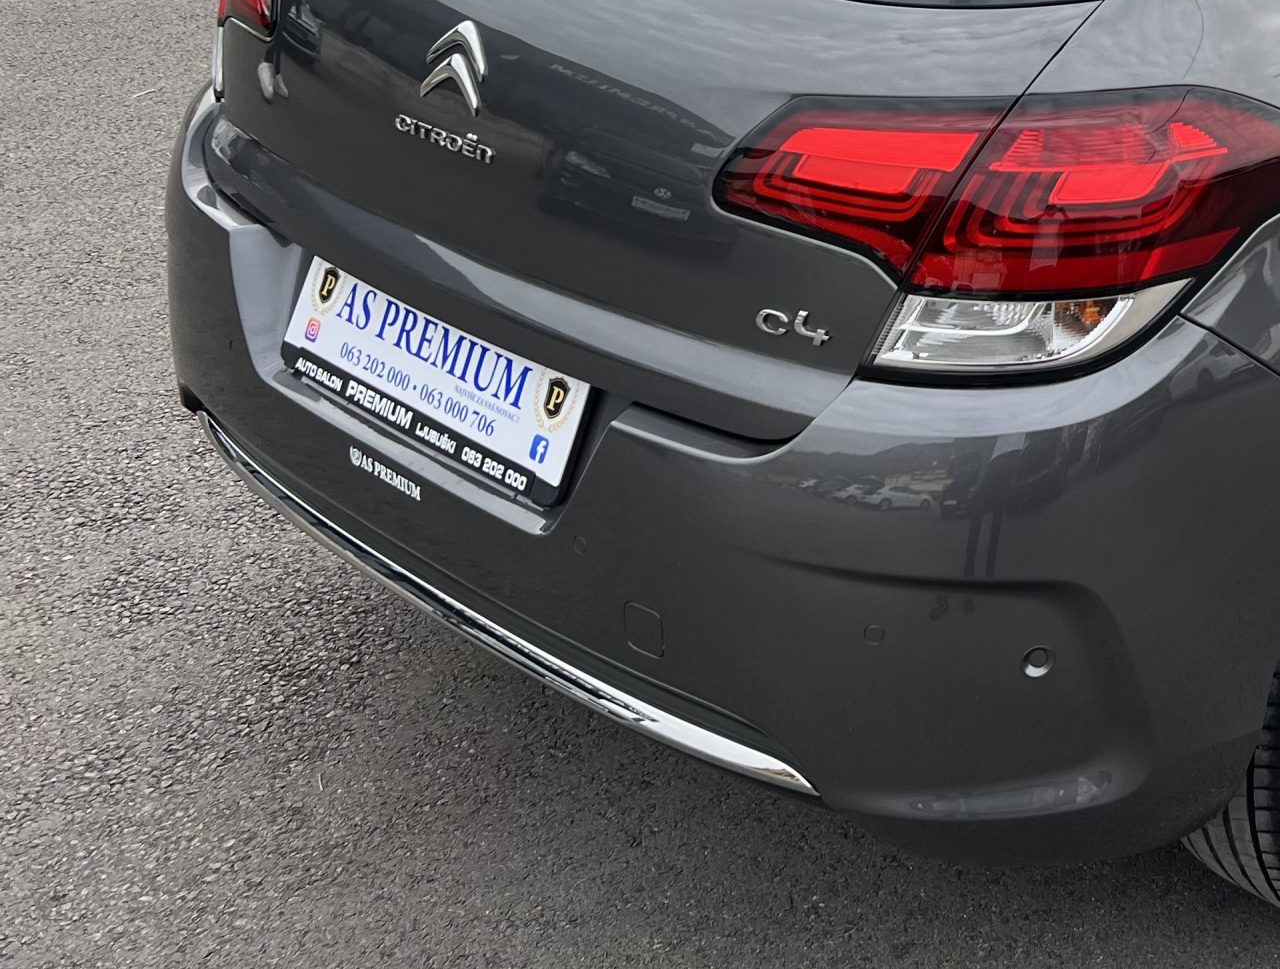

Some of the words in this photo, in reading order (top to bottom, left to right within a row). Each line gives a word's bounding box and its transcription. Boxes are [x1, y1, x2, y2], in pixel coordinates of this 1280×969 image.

[395, 114, 496, 164] CITROËN
[336, 283, 377, 330] AS
[375, 298, 533, 410] PREMIUM
[756, 308, 831, 346] C4
[340, 342, 362, 367] 063
[363, 354, 386, 379] 202
[387, 367, 411, 391] 000
[420, 384, 443, 409] 063
[444, 397, 469, 423] 000
[470, 410, 497, 437] 706
[345, 379, 414, 429] PREMIUM
[415, 422, 457, 454] LJUBUŠKI
[461, 446, 483, 468] 063
[482, 457, 505, 480] 202
[504, 468, 528, 491] 000
[360, 454, 373, 473] AS
[374, 460, 421, 501] PREMIUM
